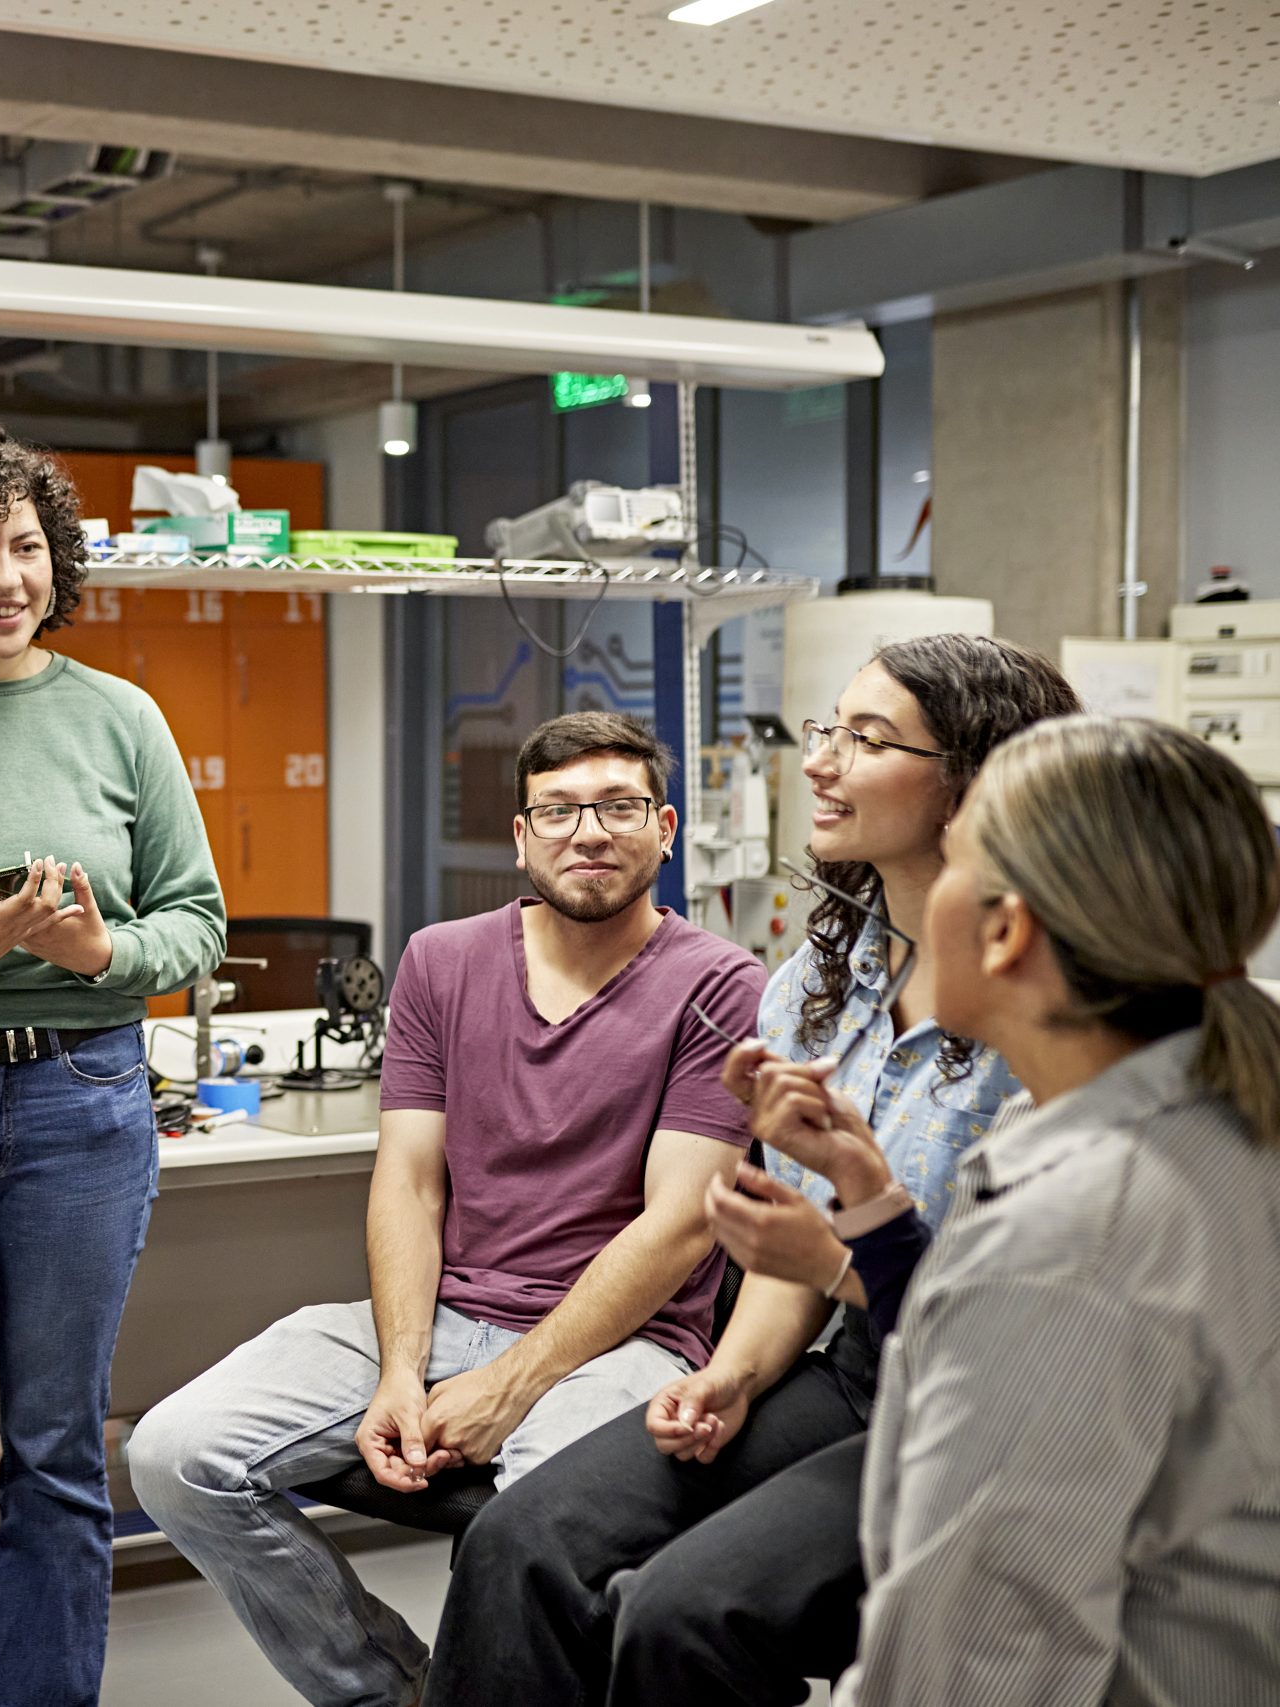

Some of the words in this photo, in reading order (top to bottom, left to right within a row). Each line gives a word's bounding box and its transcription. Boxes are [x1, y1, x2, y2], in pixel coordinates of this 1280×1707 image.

[83, 589, 121, 622] 15
[185, 591, 224, 623] 16
[190, 756, 225, 790] 19
[285, 754, 324, 788] 20
